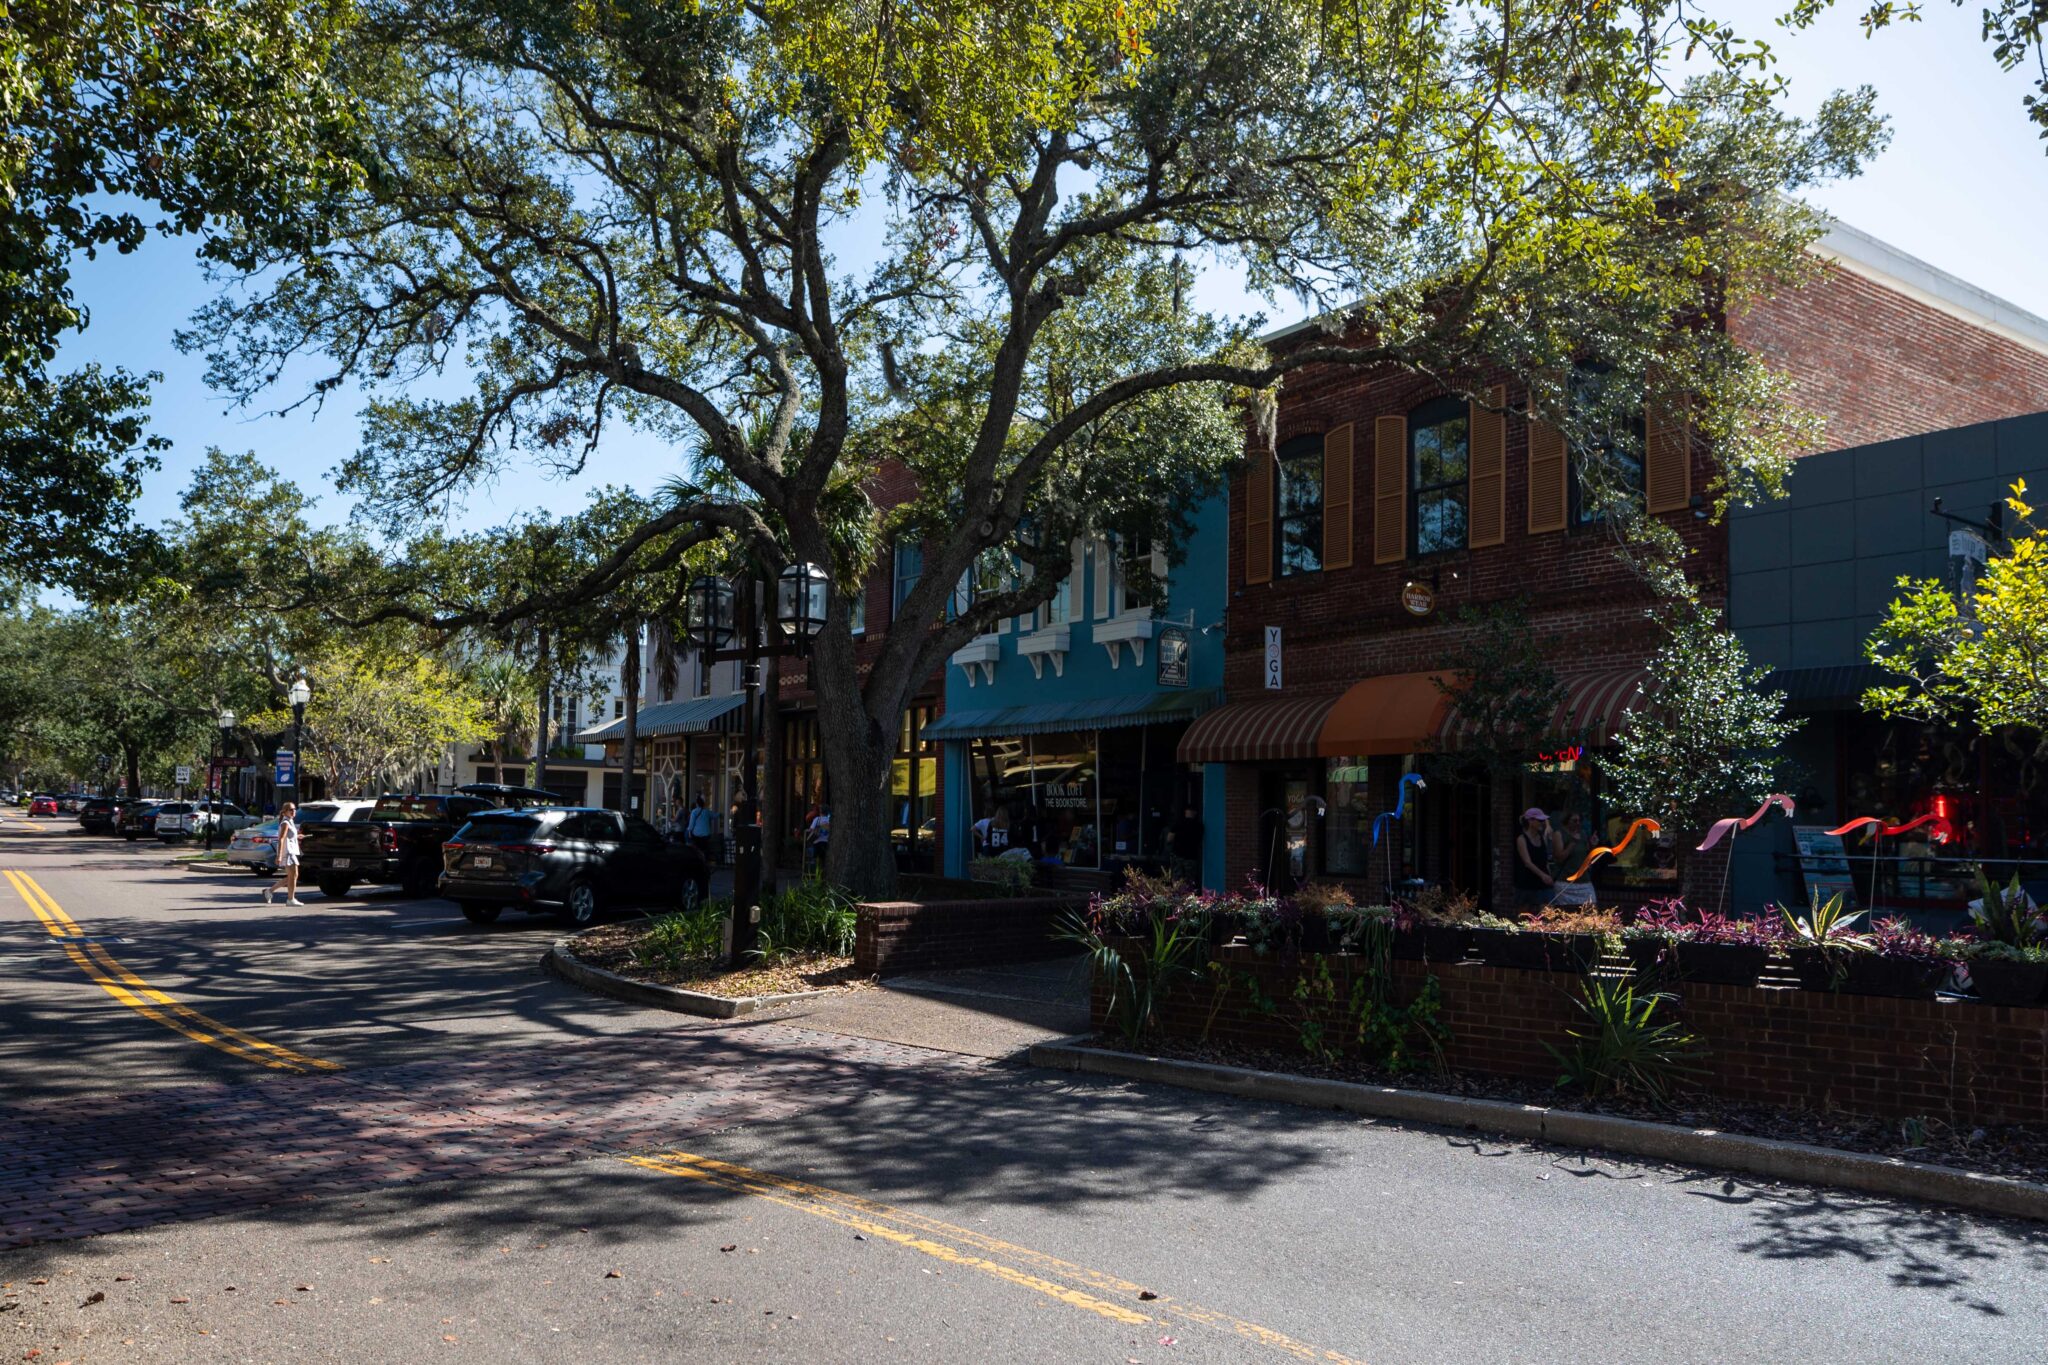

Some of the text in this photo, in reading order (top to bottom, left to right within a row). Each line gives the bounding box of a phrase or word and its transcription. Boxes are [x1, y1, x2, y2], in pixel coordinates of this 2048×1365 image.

[1046, 783, 1083, 797] BOOK LOFT
[1045, 797, 1087, 808] THE BOOKSTORE
[991, 832, 1008, 847] 84
